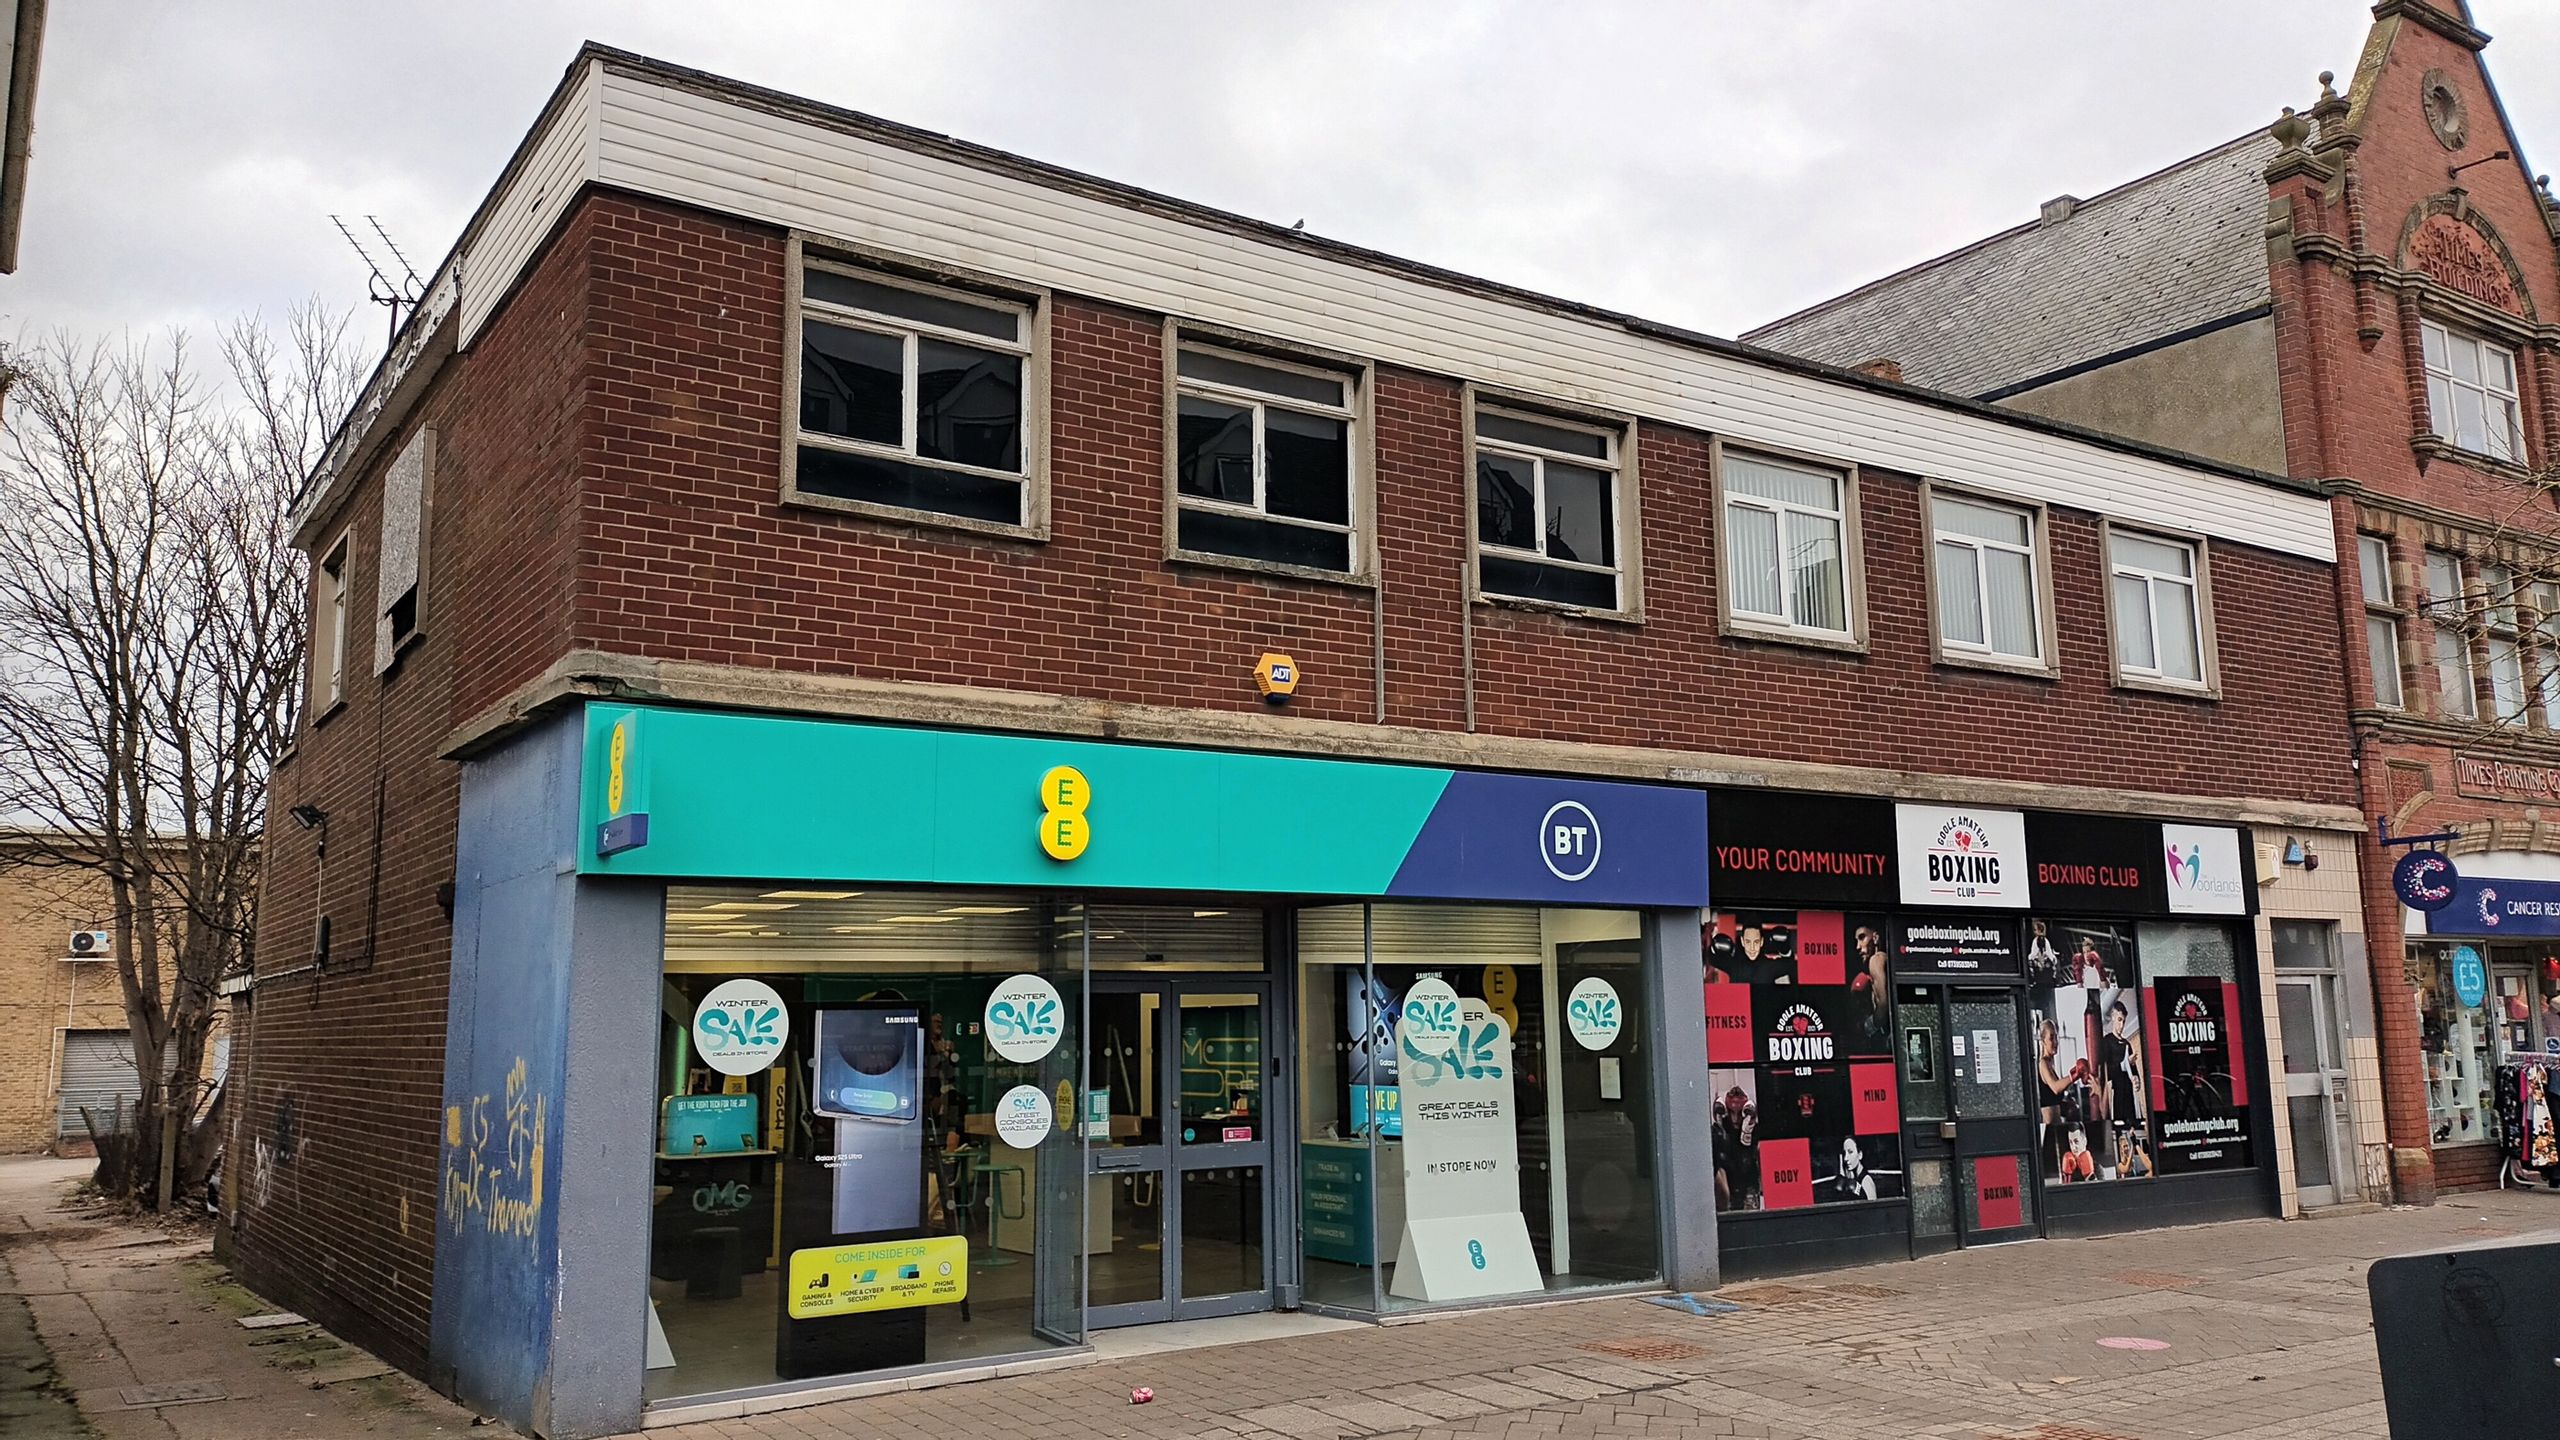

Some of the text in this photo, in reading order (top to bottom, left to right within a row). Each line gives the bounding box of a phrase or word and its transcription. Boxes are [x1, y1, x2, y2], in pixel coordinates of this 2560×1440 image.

[1271, 667, 1290, 680] ADT
[2458, 757, 2495, 786] TIMES
[2495, 761, 2547, 791] PRINTING
[1058, 779, 1073, 846] EE
[1937, 815, 1989, 848] GOOLE AMATEUR
[1554, 825, 1588, 856] BT
[1716, 846, 1886, 876] YOUR COMMUNITY
[1928, 854, 2000, 884] BOXING
[2038, 863, 2139, 887] BOXING CLUB
[1957, 887, 1976, 898] CLUB
[2507, 901, 2560, 916] CANCER RES
[1907, 925, 2000, 944] gooleboxingclub.org
[1804, 942, 1837, 956] BOXING
[1416, 971, 1443, 979] SAMSUNG
[2459, 963, 2480, 990] £5
[716, 999, 768, 1007] WINTER
[885, 1016, 918, 1024] SAMSUNG
[988, 1000, 1056, 1041] SALE
[1405, 1001, 1457, 1034] SALE
[1570, 999, 1617, 1031] SALE
[1777, 1003, 1824, 1031] GOOLE AMATEUR
[698, 1007, 780, 1050] SALE
[1706, 1016, 1747, 1029] FITNESS
[2169, 1021, 2215, 1042] BOXING
[1768, 1036, 1833, 1061] BOXING
[2188, 1046, 2201, 1054] CLUB
[1379, 1059, 1396, 1067] Galaxy
[1794, 1066, 1812, 1076] CLUB
[1387, 1091, 1398, 1111] UP
[1863, 1089, 1886, 1102] MIND
[677, 1103, 686, 1111] GET
[695, 1101, 709, 1109] RIGHT
[709, 1100, 721, 1108] TECH
[721, 1100, 729, 1108] FOR
[730, 1099, 738, 1107] THE
[1013, 1098, 1036, 1111] SALE
[1418, 1101, 1498, 1111] GREAT DEALS
[1419, 1110, 1499, 1120] THIS WINTER
[2164, 1117, 2239, 1138] gooleboxingclub.org
[1427, 1159, 1497, 1173] IN STORE NOW
[1774, 1169, 1799, 1184] BODY
[692, 1179, 752, 1212] OMG
[1984, 1186, 2013, 1200] BOXING
[835, 1246, 926, 1264] COME INSIDE FOR
[840, 1289, 858, 1297] HOME
[890, 1282, 928, 1292] BROADBAND
[932, 1286, 957, 1294] REPAIRS
[800, 1299, 834, 1308] CONSOLES
[848, 1295, 877, 1303] SECURITY
